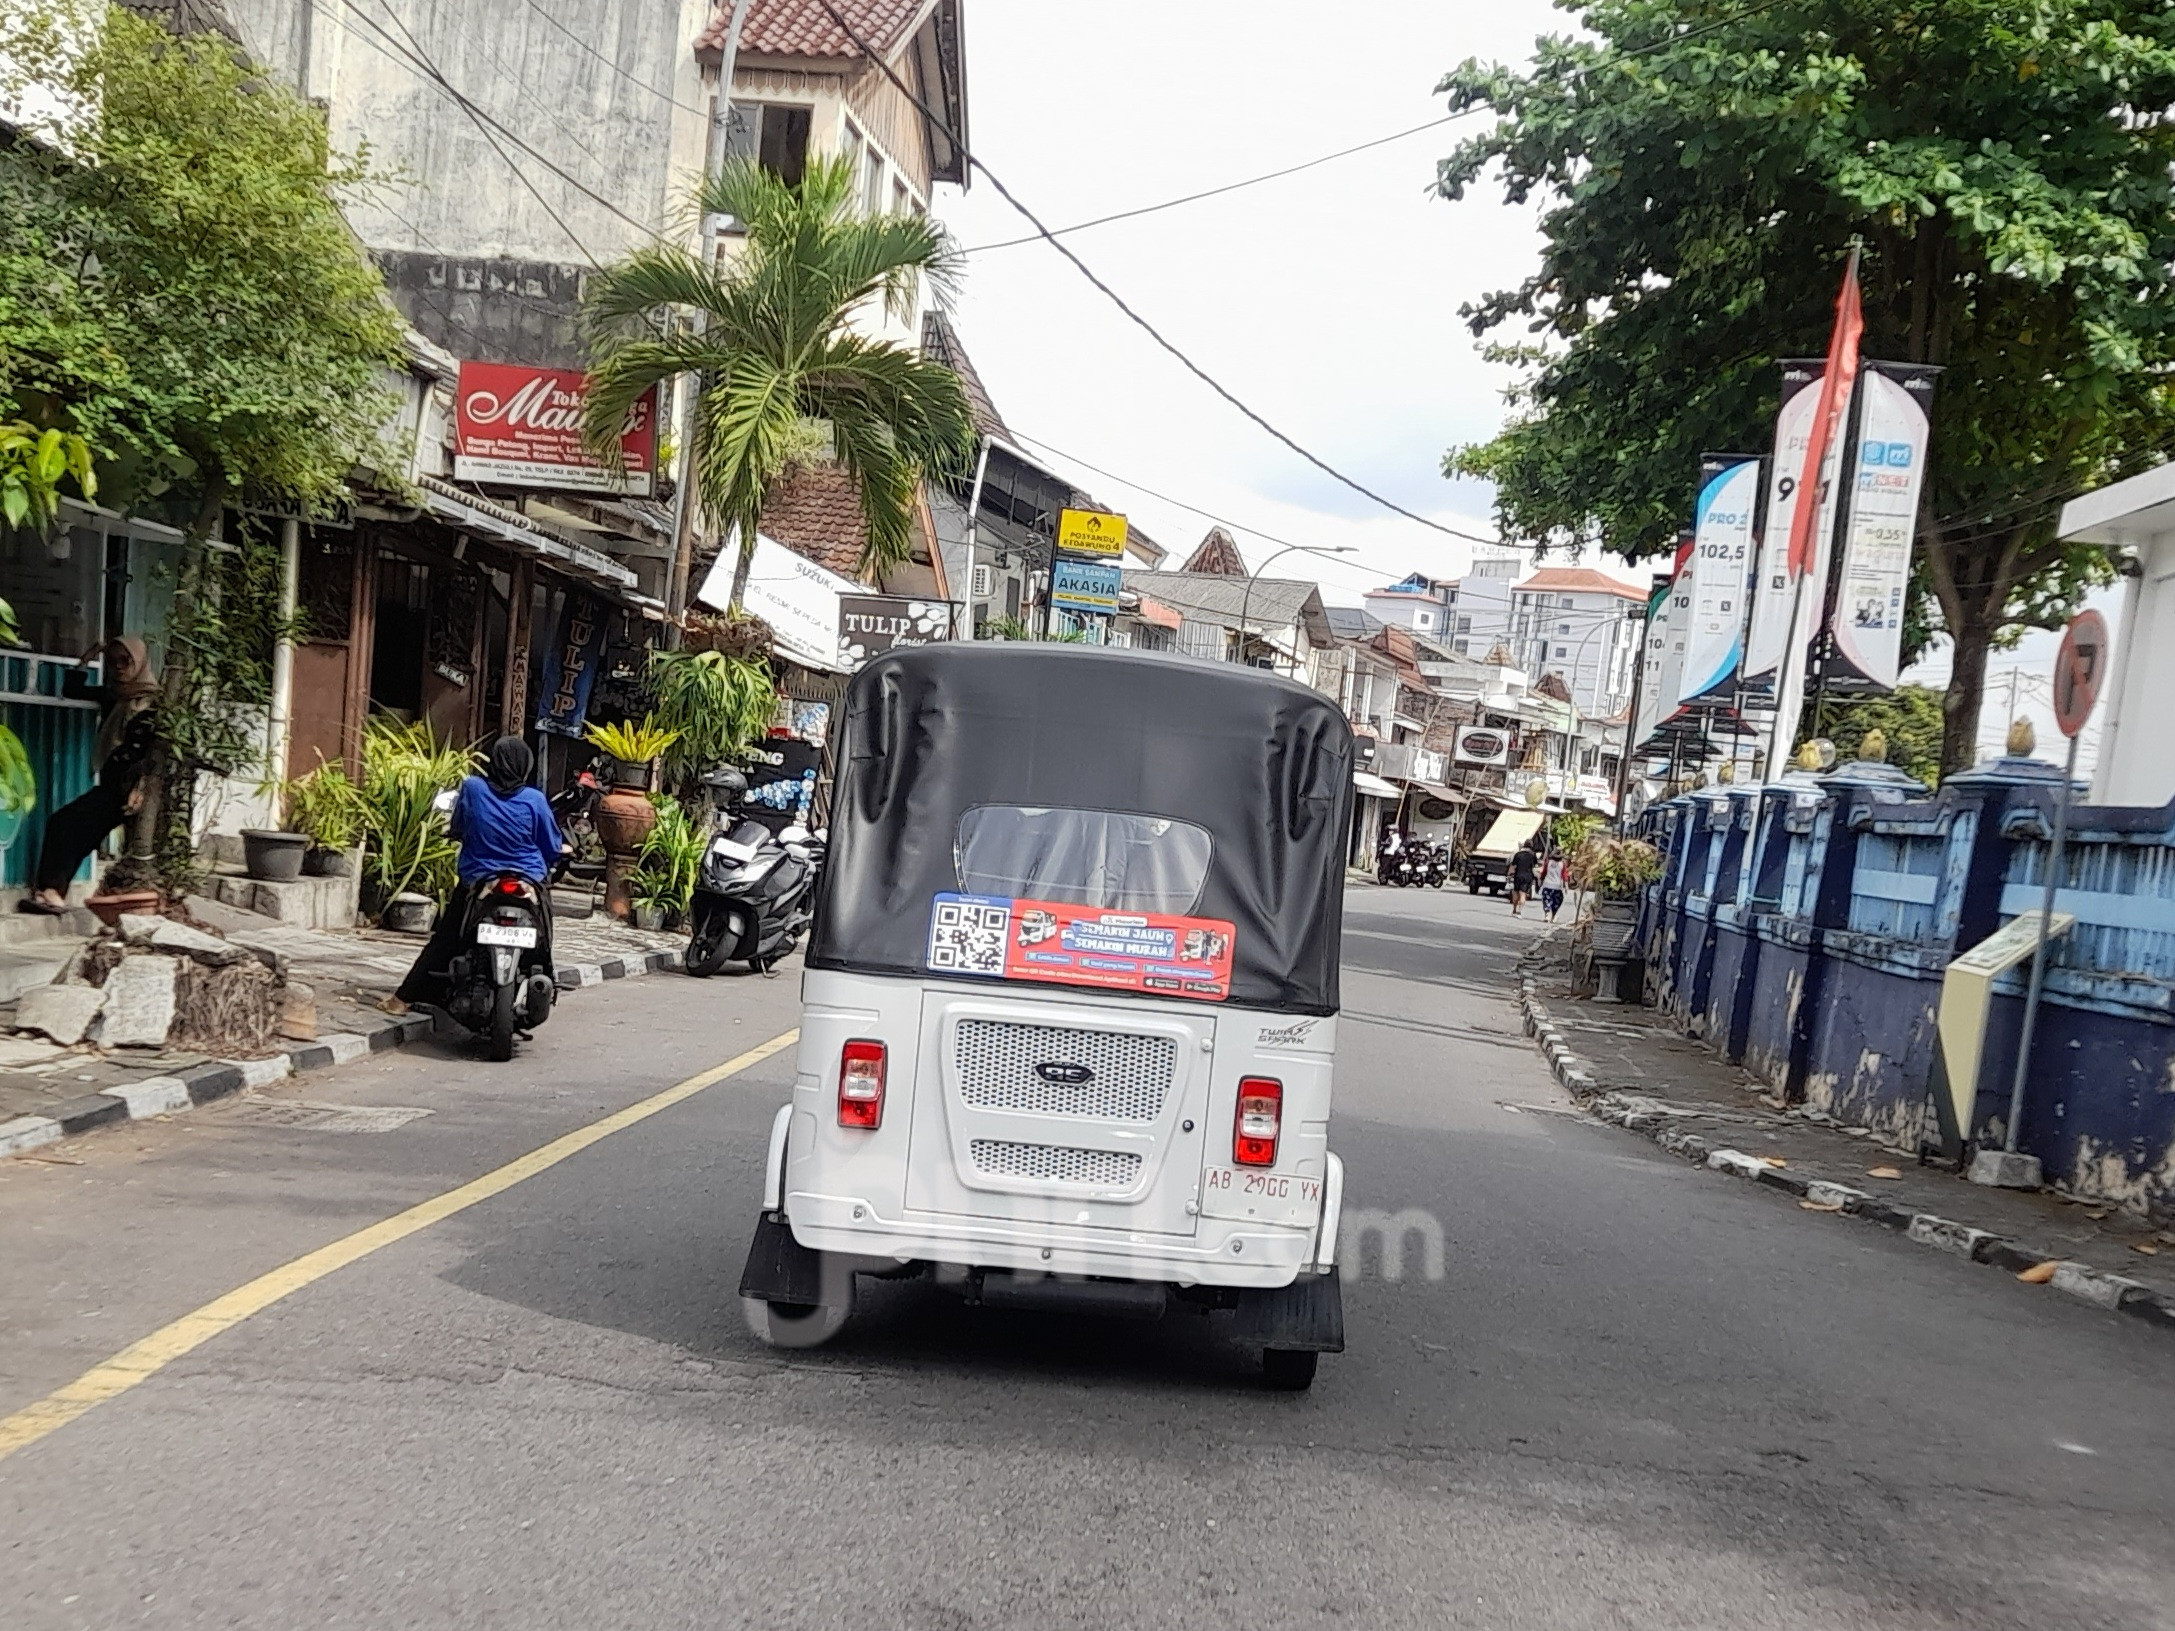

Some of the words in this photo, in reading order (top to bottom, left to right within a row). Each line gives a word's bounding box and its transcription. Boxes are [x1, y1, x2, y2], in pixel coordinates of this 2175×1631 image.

[1708, 512, 1737, 525] PRO
[1113, 542, 1120, 551] 4
[1699, 544, 1746, 562] 102,5
[794, 562, 835, 590] SUZUKI
[1058, 577, 1116, 596] AKASIA
[845, 613, 912, 636] TULIP
[549, 593, 599, 718] TULIP
[1082, 923, 1130, 938] SEMAKIN
[1132, 928, 1165, 942] JAUH
[1074, 937, 1124, 952] SEMAKIN
[1126, 944, 1168, 957] MURAH
[1208, 1170, 1231, 1189] AB
[1300, 1181, 1320, 1202] YX
